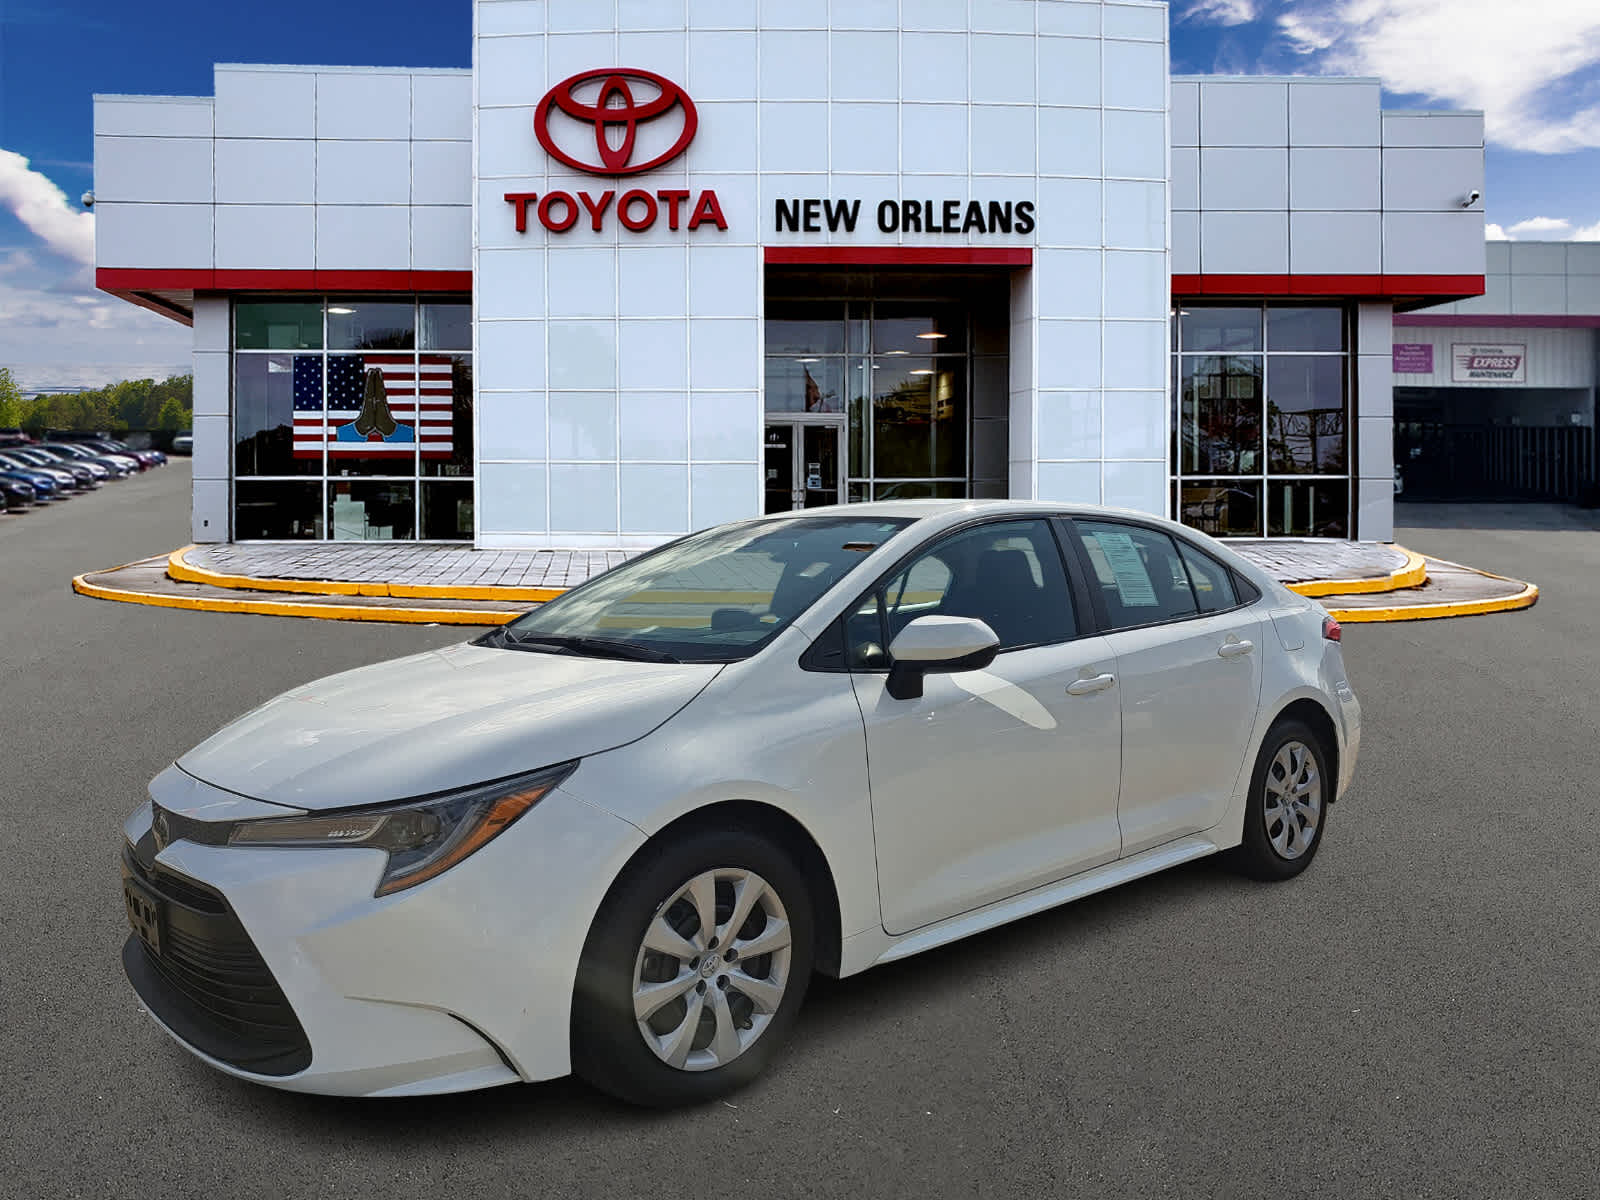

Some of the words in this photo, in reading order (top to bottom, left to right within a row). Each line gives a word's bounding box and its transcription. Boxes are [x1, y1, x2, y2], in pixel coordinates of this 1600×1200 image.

[504, 189, 728, 233] TOYOTA
[775, 199, 861, 232] NEW
[877, 199, 1035, 234] ORLEANS
[1473, 358, 1517, 368] EXPRESS
